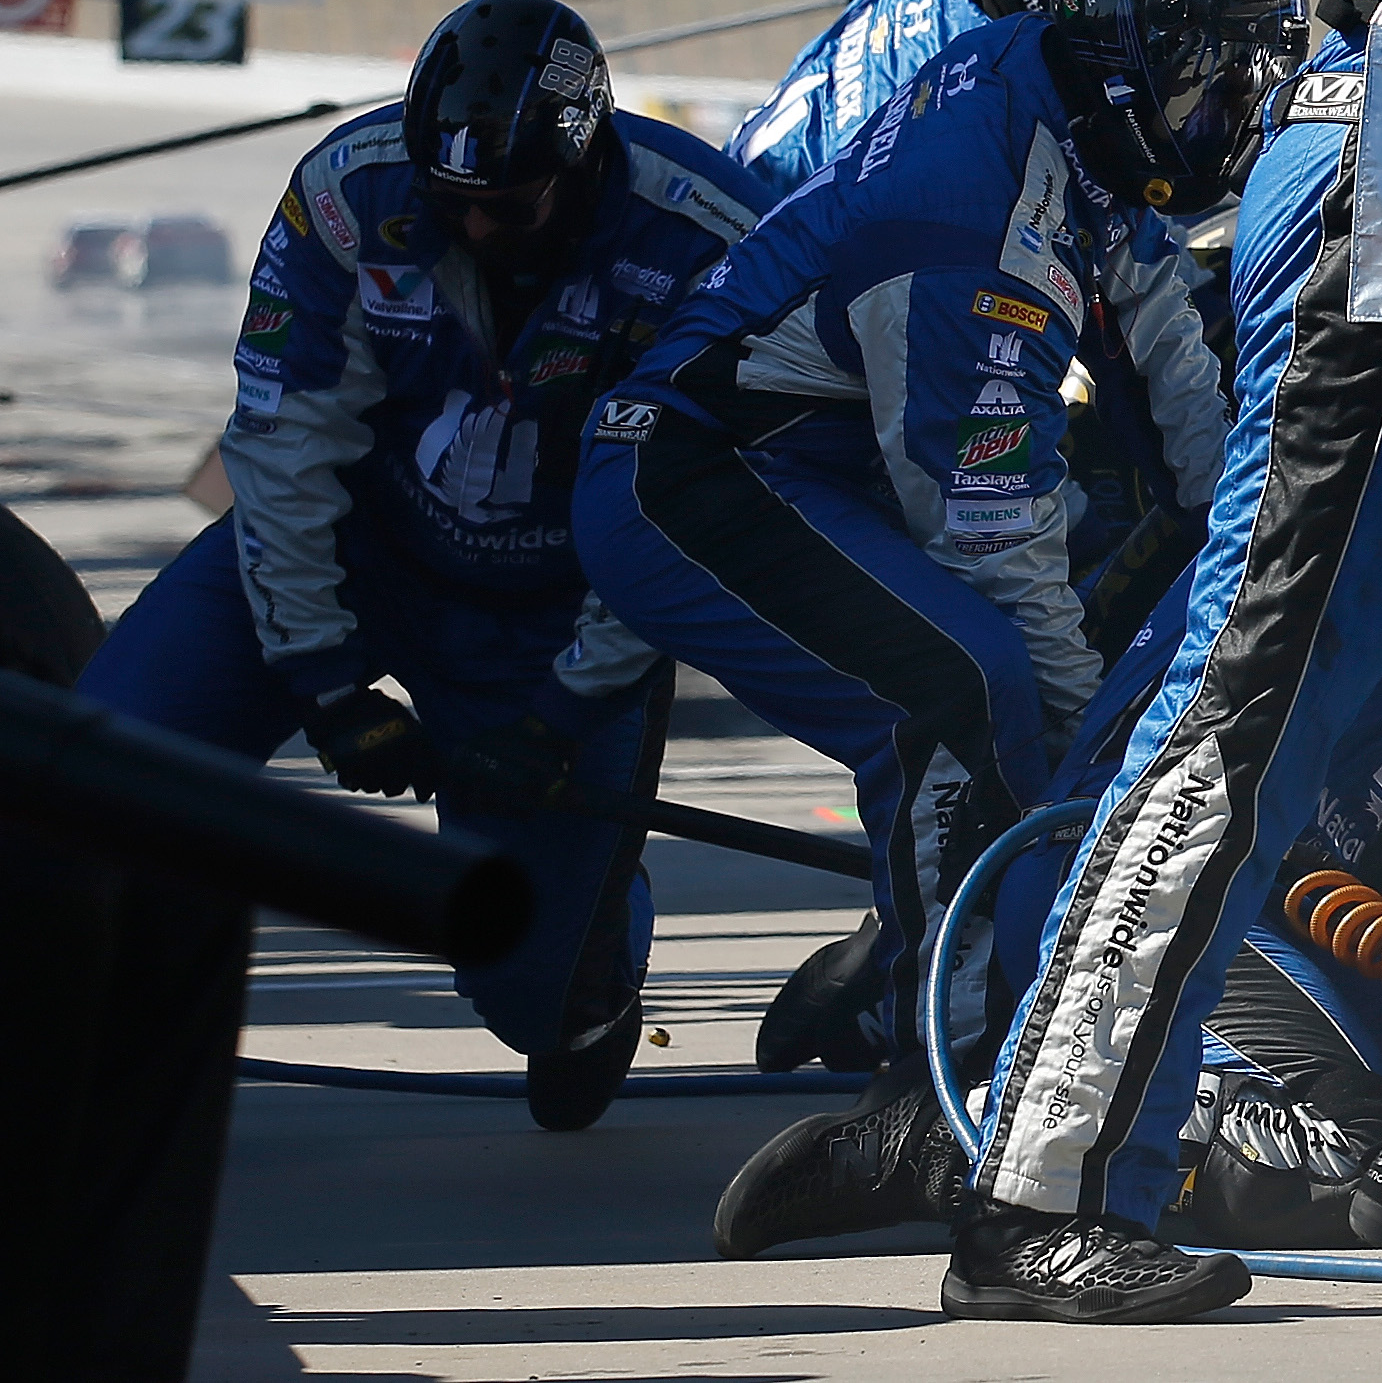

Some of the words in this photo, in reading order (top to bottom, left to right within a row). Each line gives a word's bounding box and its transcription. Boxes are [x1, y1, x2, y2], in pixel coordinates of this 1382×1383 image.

[538, 38, 595, 100] 88
[1328, 105, 1359, 118] WEAR
[1125, 108, 1157, 165] Nationwide
[429, 165, 488, 186] Nationwide
[316, 192, 356, 248] SIMPSON
[689, 189, 750, 238] Nationwide
[998, 301, 1047, 328] BOSCH
[975, 361, 1027, 379] Nationwide
[970, 404, 1026, 416] AXALTA
[620, 430, 648, 441] WEAR
[951, 470, 1028, 491] TaxSlayer
[956, 507, 1022, 522] SIEMENS
[1102, 772, 1216, 970] Nationwide
[1096, 974, 1113, 996] is
[1085, 996, 1105, 1026] on
[1063, 1024, 1095, 1085] your
[1042, 1084, 1070, 1131] side
